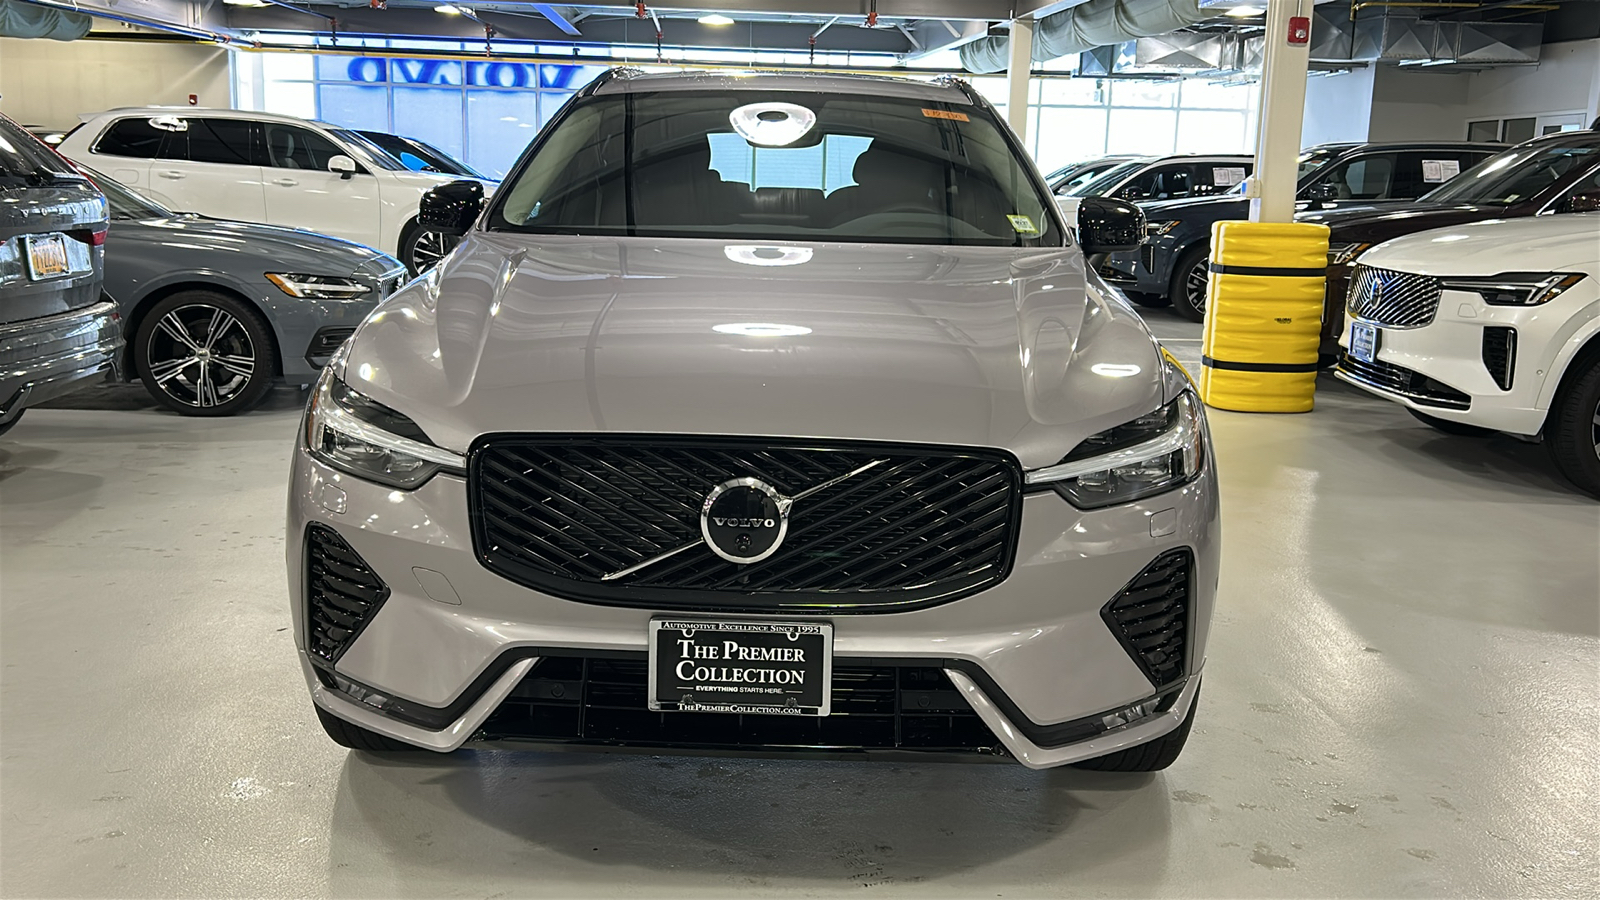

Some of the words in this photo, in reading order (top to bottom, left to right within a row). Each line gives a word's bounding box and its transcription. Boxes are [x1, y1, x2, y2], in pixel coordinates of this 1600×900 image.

[713, 517, 775, 528] VOLVO
[663, 621, 717, 630] AUTOMOTIVE
[718, 622, 768, 632] EXCELLENCE
[770, 624, 795, 633] SINCE
[676, 639, 719, 660] THE
[722, 640, 805, 662] PREMIER
[675, 660, 805, 685] COLLECTION
[695, 685, 739, 693] EVERYTHING
[739, 686, 764, 694] STARTS
